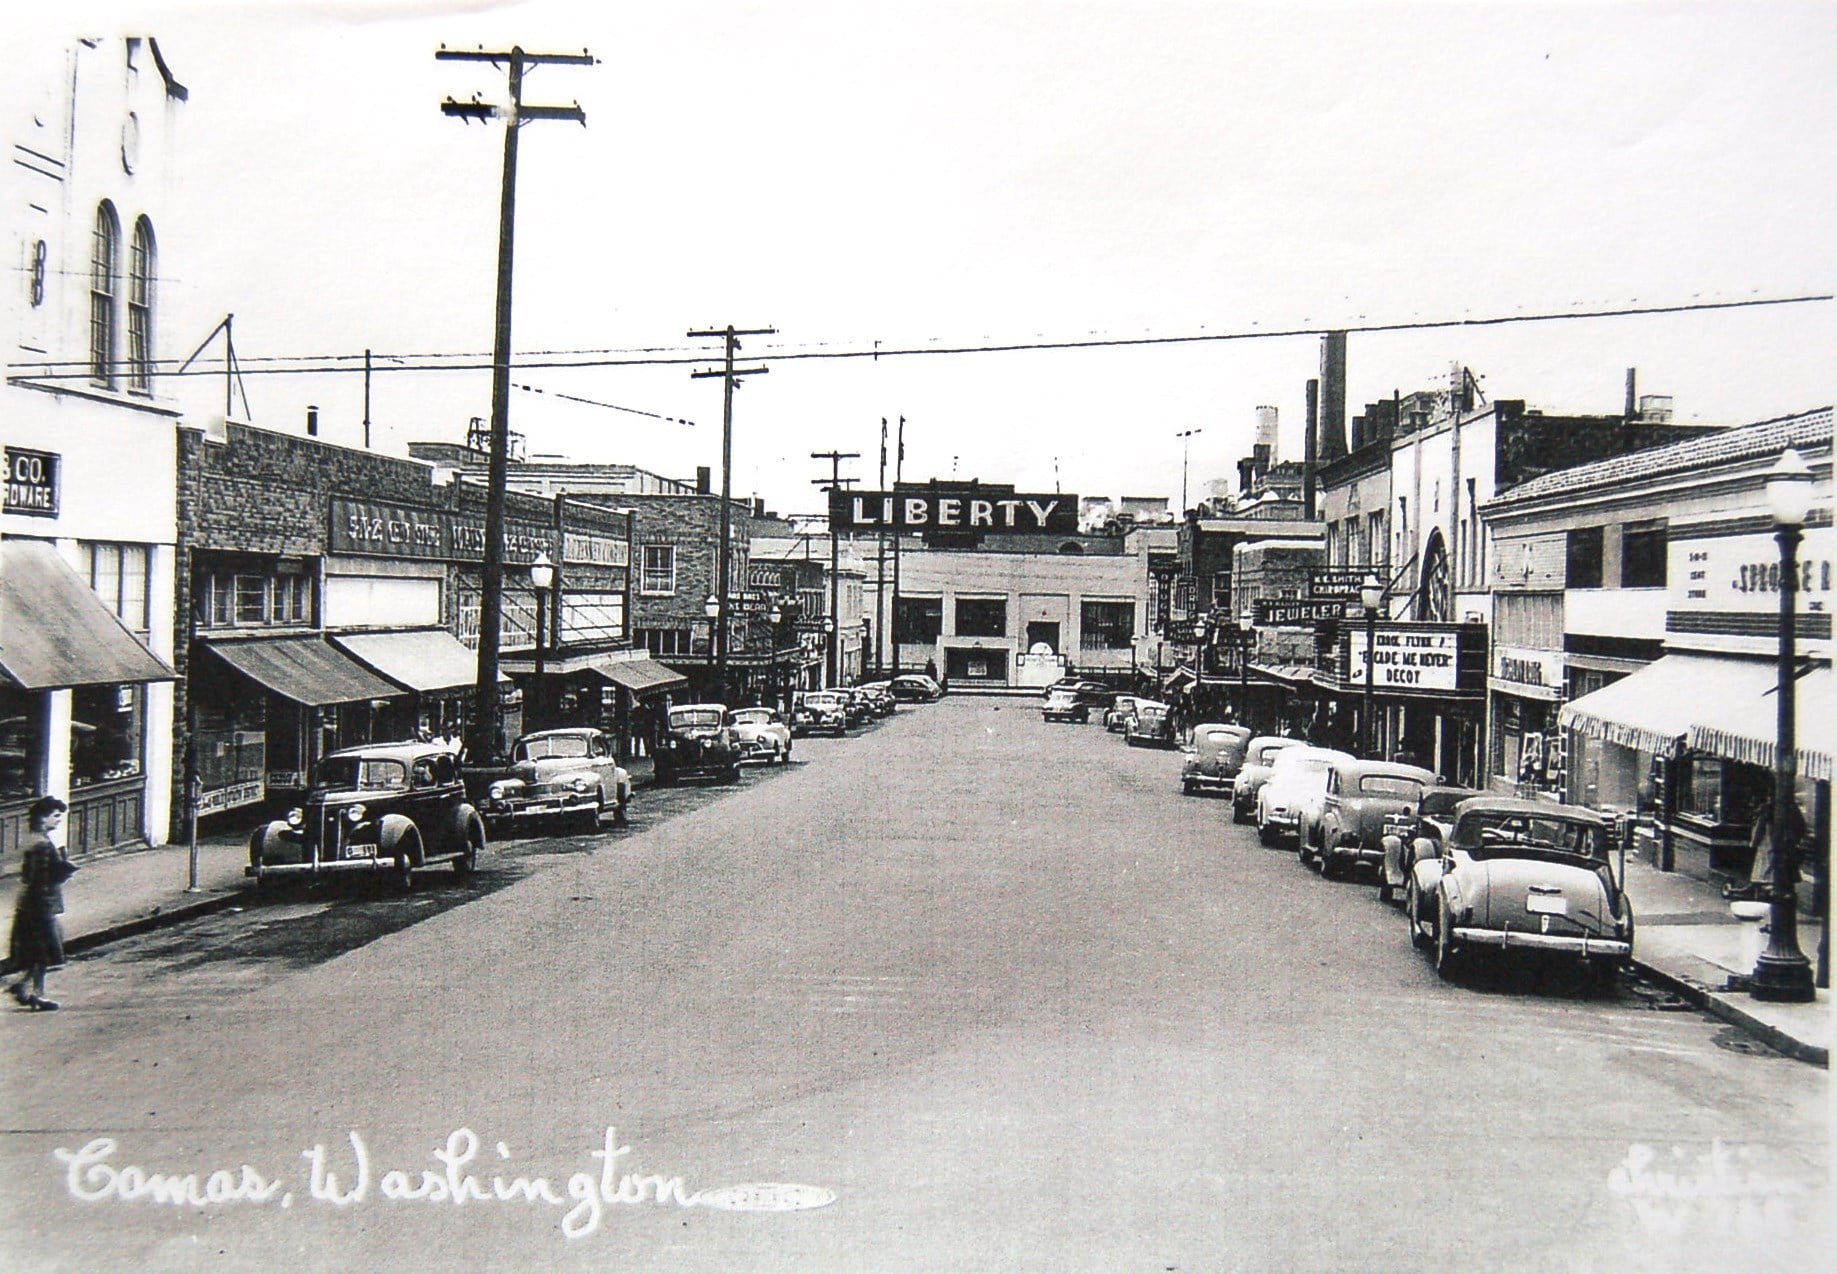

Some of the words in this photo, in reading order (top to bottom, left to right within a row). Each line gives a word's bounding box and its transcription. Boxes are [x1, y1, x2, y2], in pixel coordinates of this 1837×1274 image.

[16, 456, 45, 484] CO.
[853, 497, 1058, 526] LIBERTY
[1264, 604, 1342, 623] JEWELER
